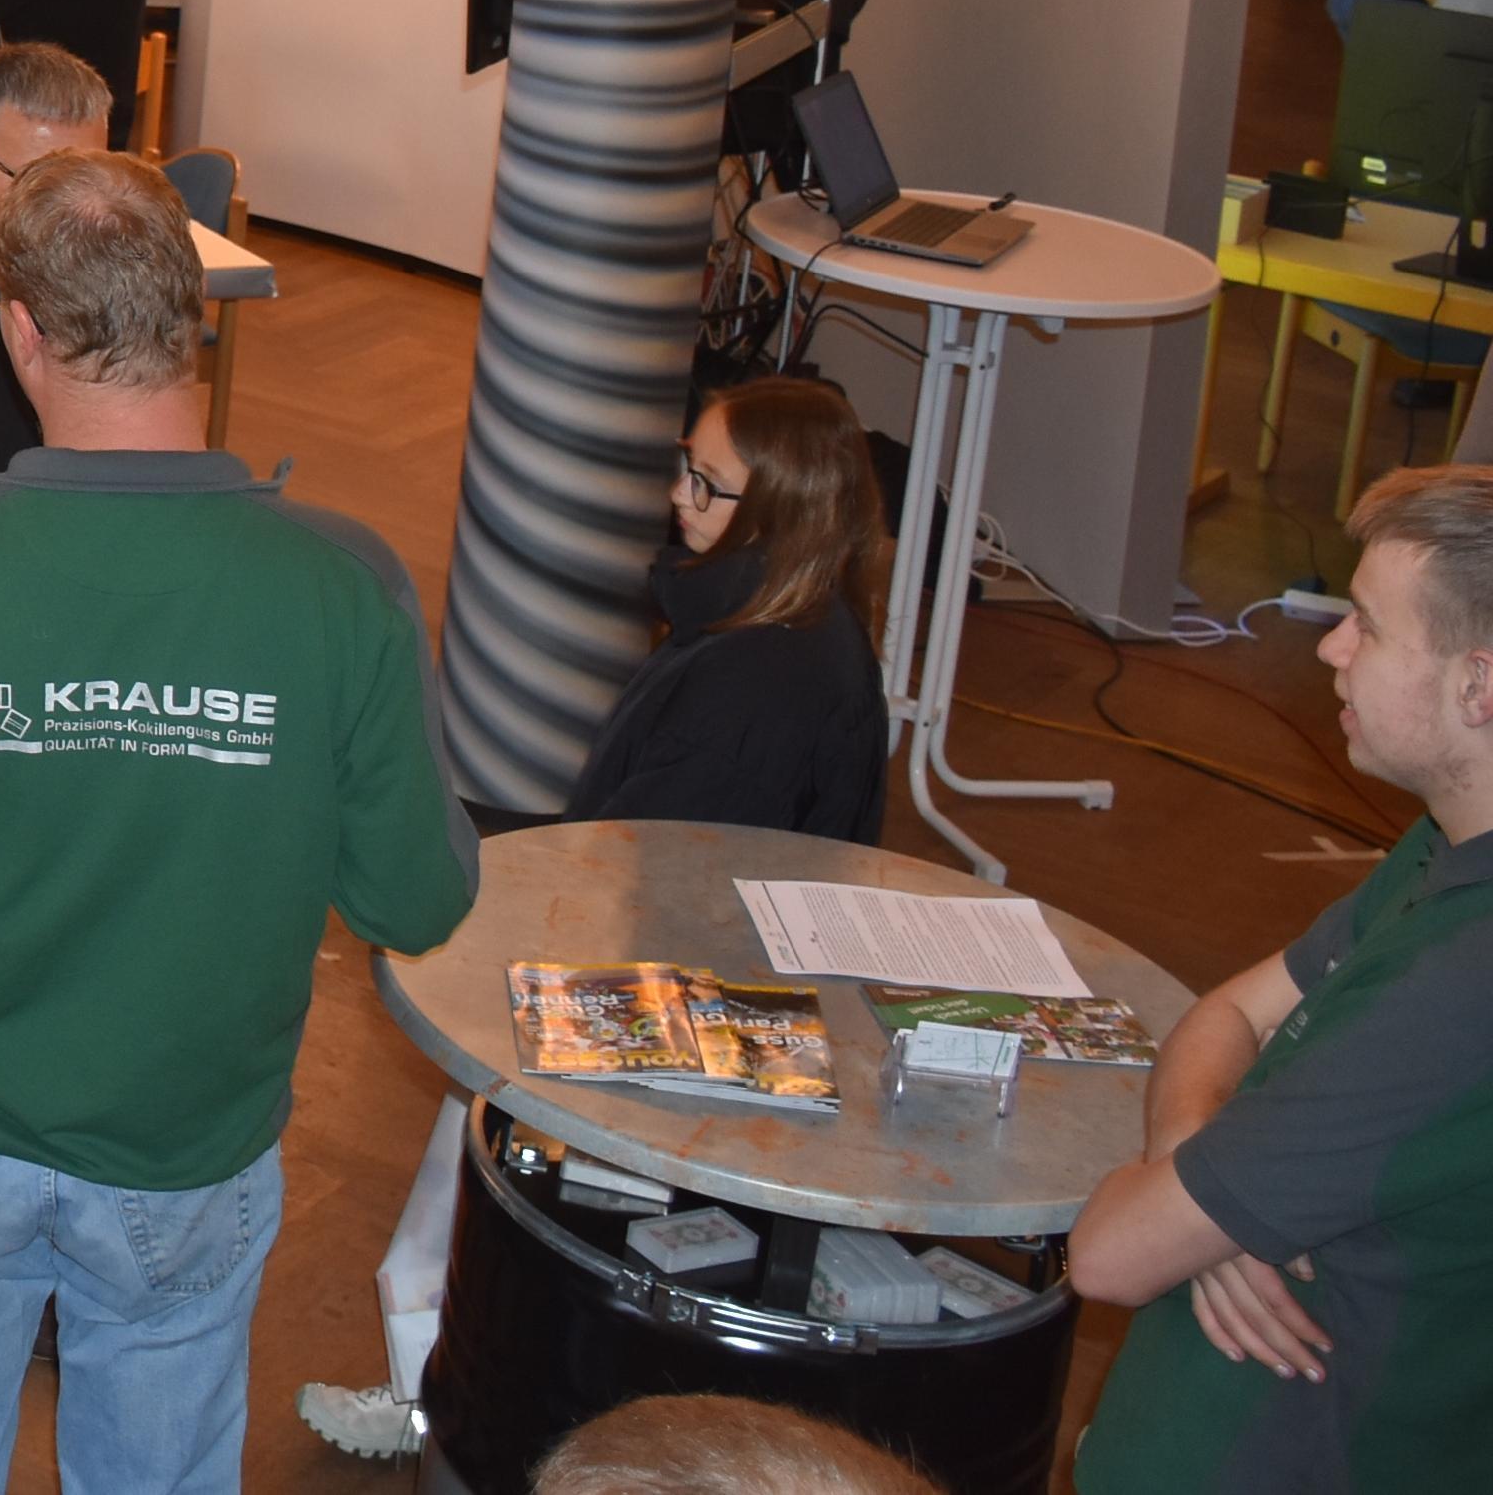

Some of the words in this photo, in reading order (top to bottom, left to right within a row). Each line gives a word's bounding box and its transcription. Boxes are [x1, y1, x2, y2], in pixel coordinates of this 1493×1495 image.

[44, 680, 277, 725] KRAUSE
[226, 730, 274, 746] GmbH
[120, 739, 137, 752] IN
[141, 741, 186, 756] FORM
[752, 1034, 824, 1049] Guss
